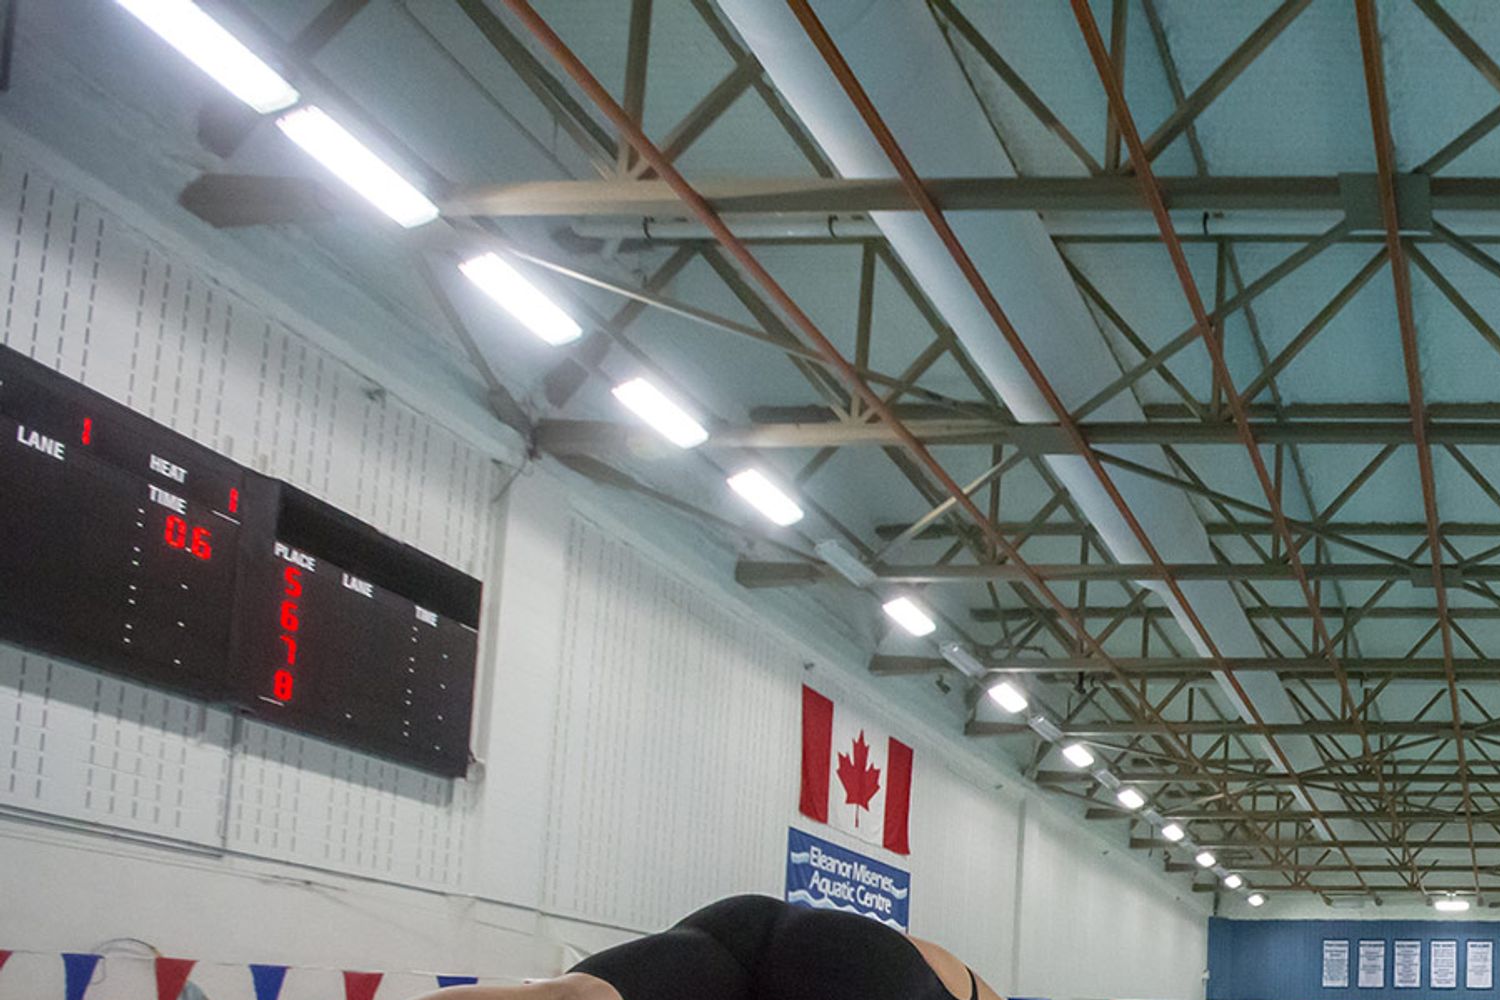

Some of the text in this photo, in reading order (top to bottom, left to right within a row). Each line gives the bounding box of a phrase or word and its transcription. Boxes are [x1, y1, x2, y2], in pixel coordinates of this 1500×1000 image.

[17, 425, 65, 460] LANE
[150, 454, 188, 483] HEAT
[148, 483, 187, 514] TIME
[274, 541, 316, 572] PLACE
[284, 566, 302, 597] 5
[342, 572, 374, 598] LANE
[280, 600, 299, 631] 6
[274, 669, 293, 700] 8
[810, 845, 894, 893] Eleanor Misener
[809, 870, 893, 914] Aquatic Centre
